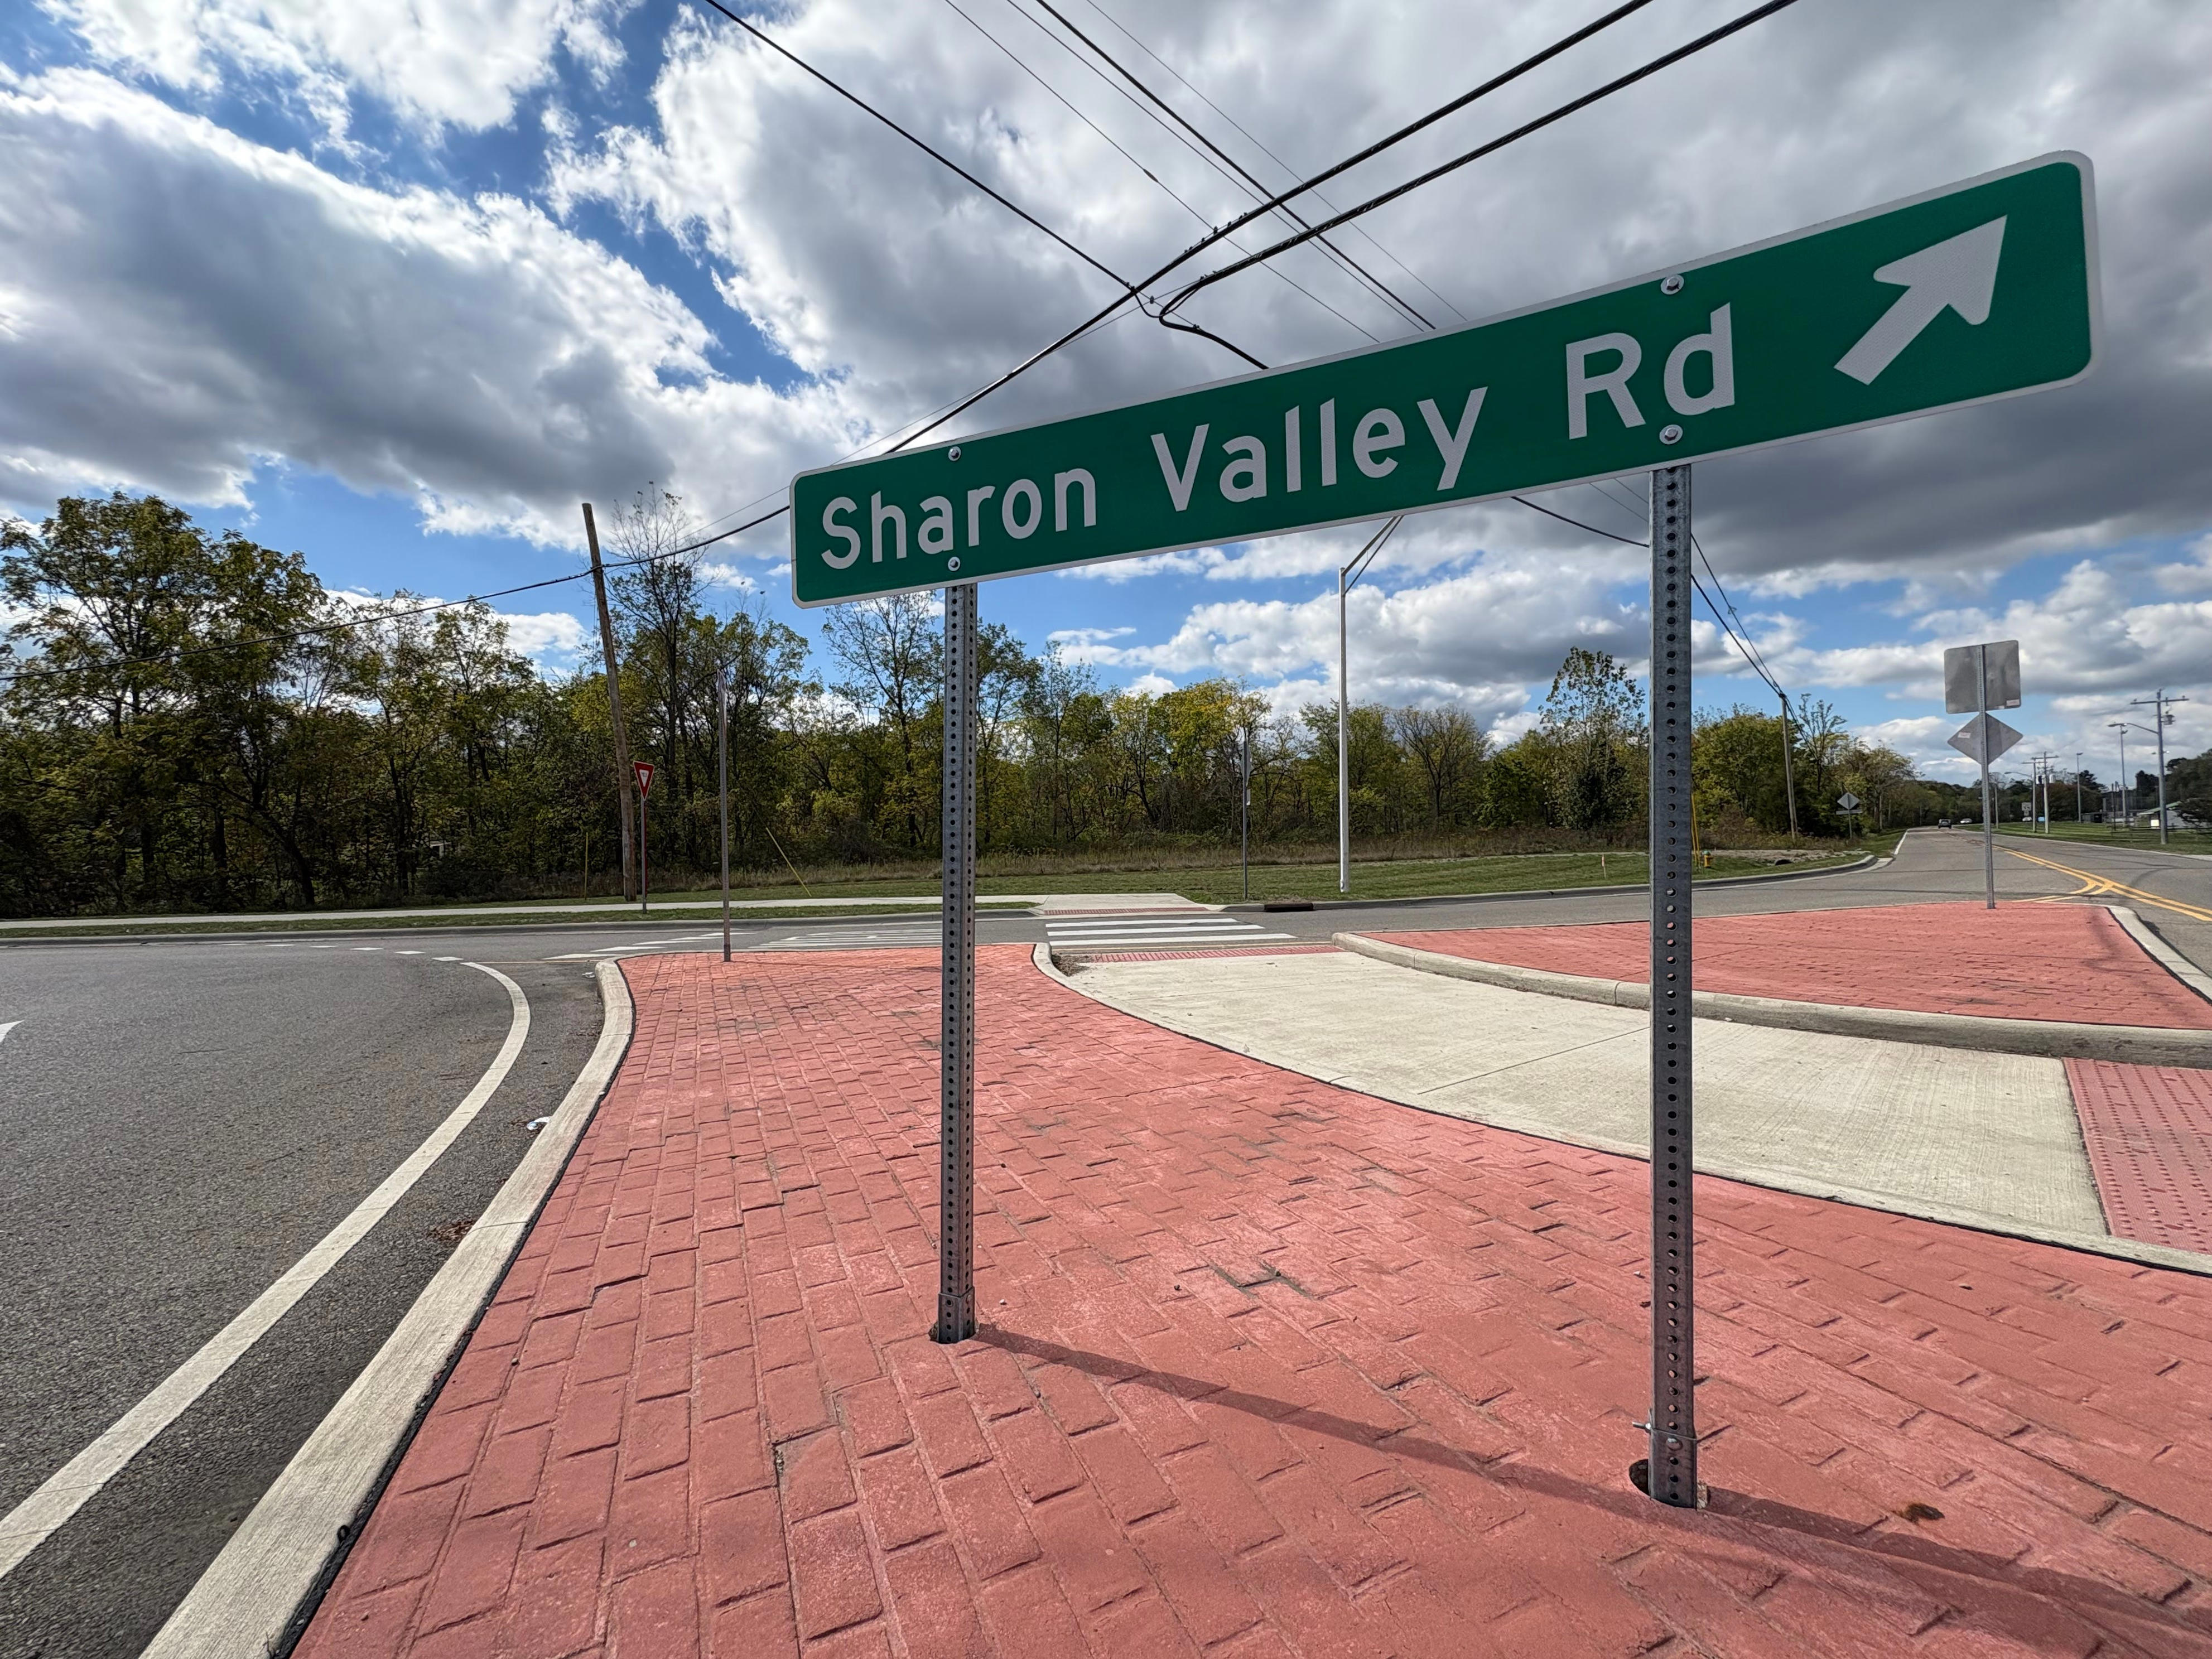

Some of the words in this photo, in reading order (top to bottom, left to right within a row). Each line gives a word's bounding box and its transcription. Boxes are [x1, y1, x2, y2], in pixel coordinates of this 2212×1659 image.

[821, 468, 1096, 569] Sharon
[1151, 387, 1487, 512] Valley
[1566, 303, 1735, 440] Rd
